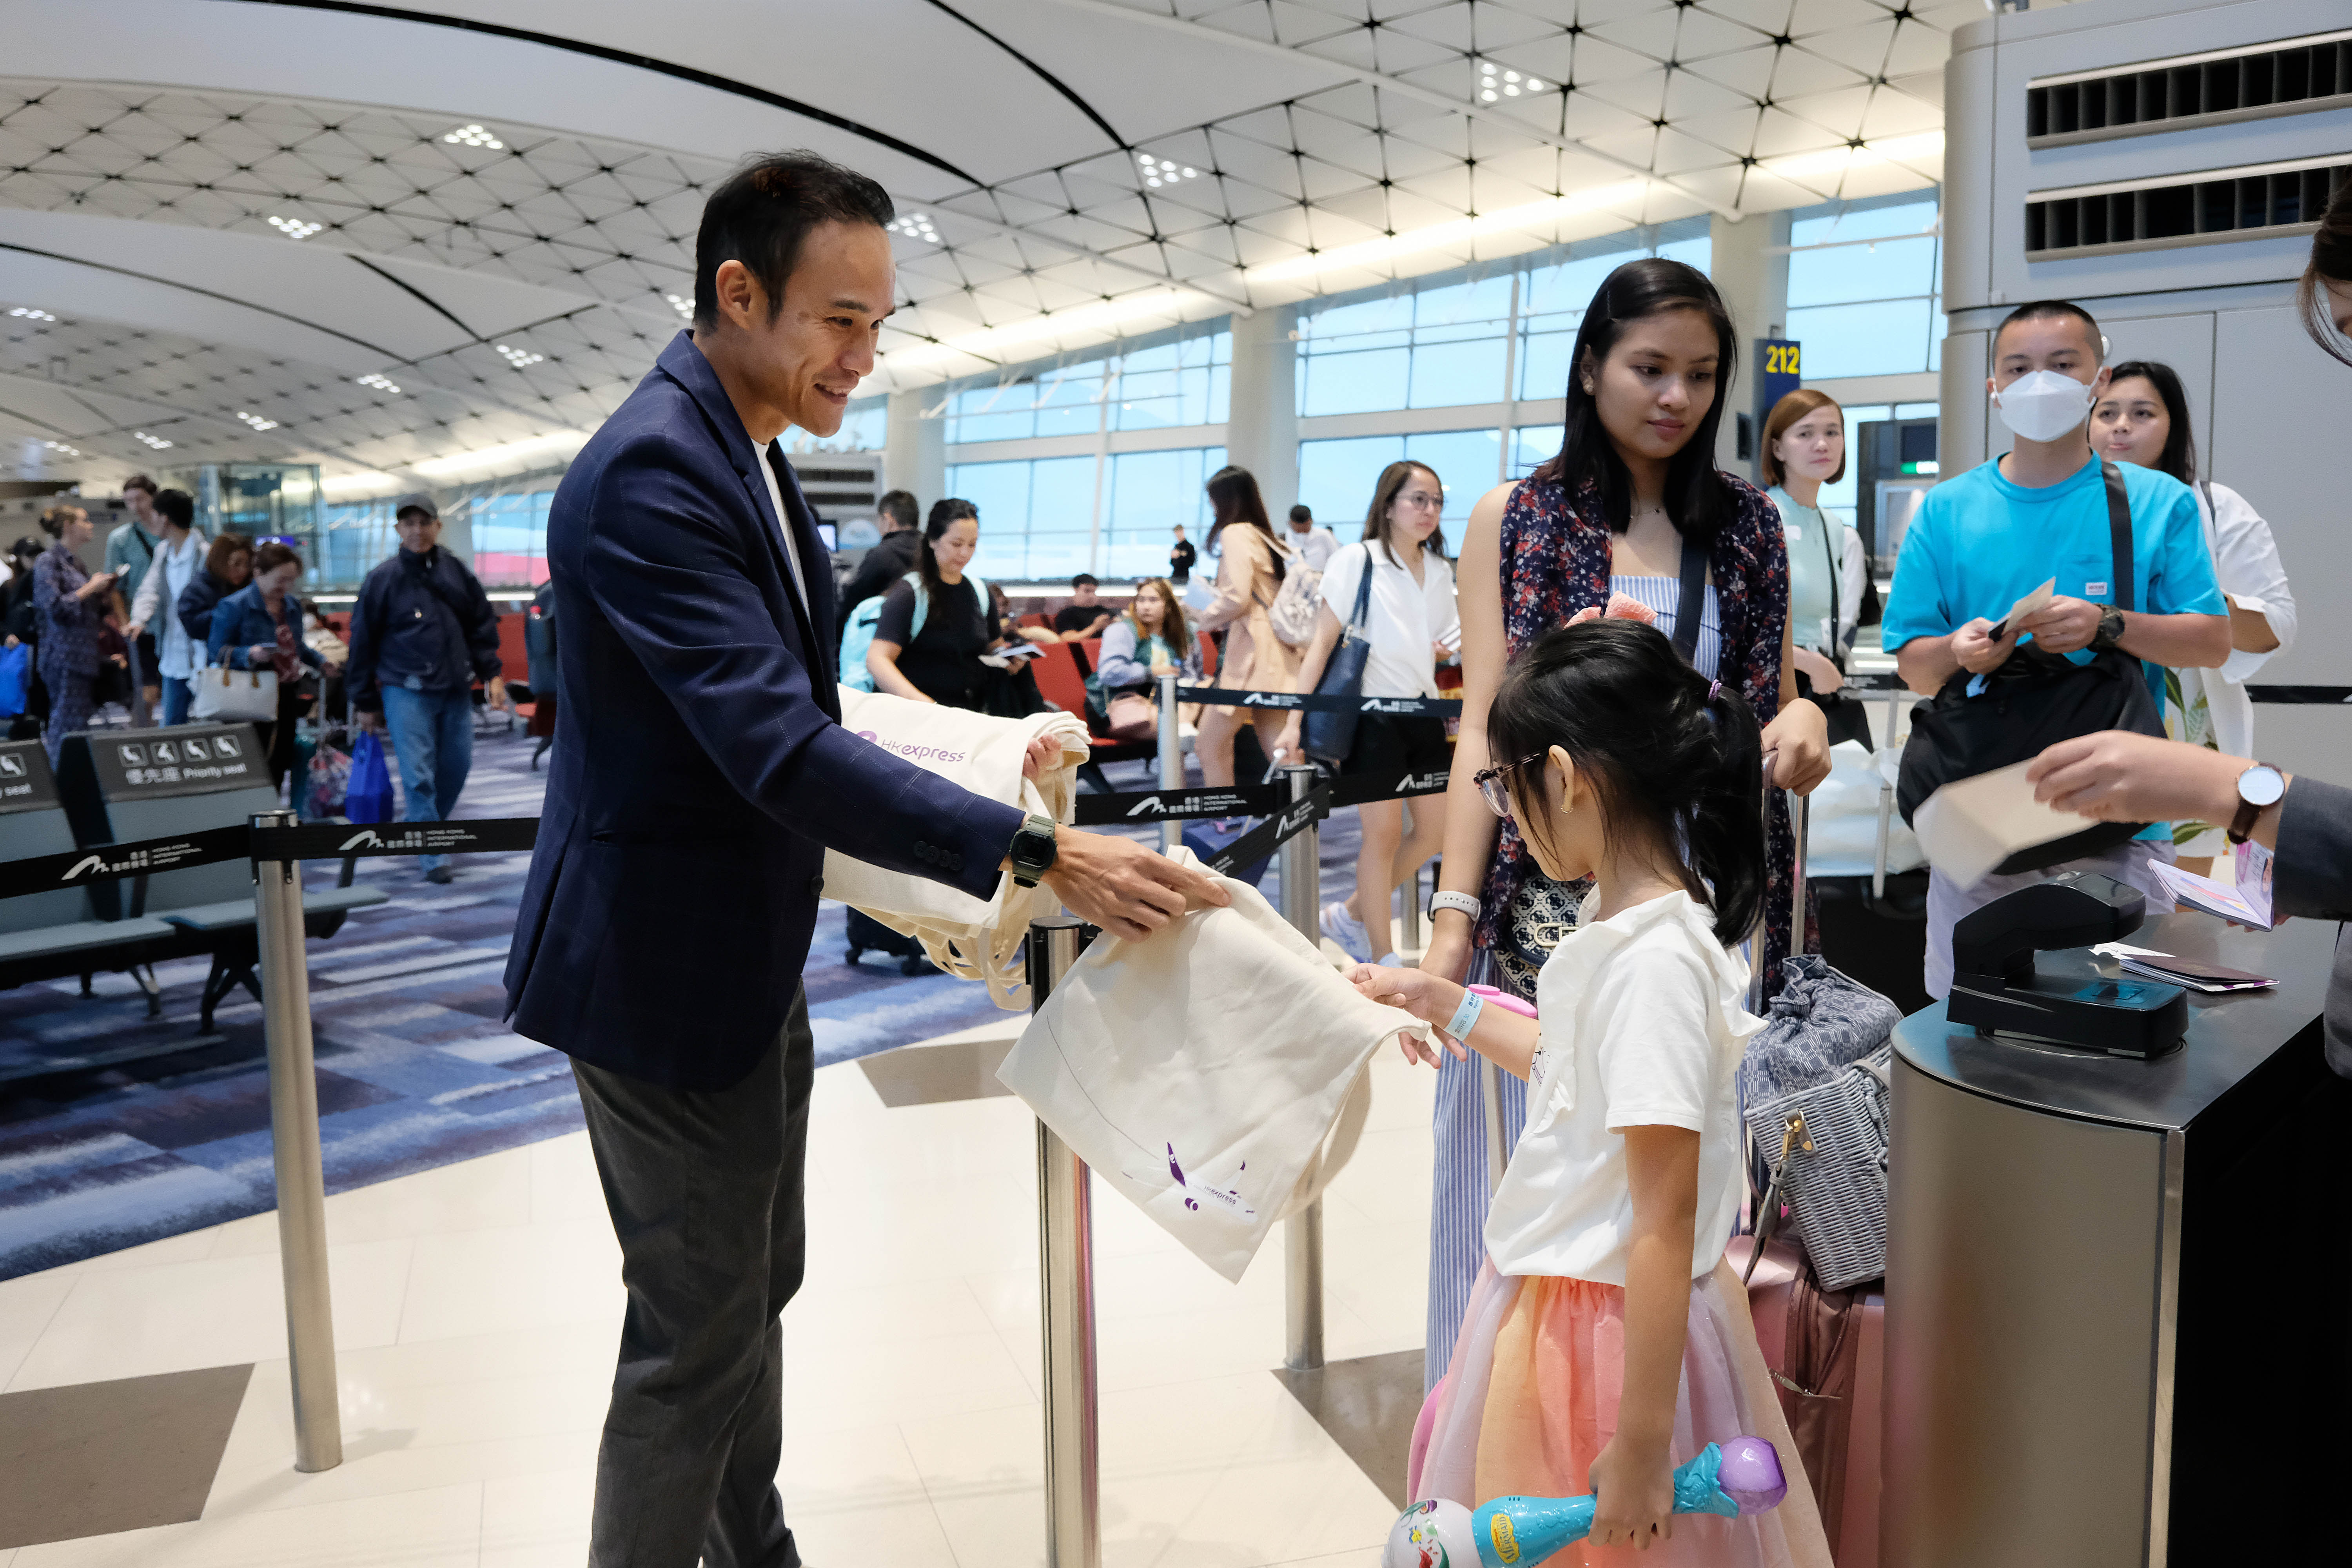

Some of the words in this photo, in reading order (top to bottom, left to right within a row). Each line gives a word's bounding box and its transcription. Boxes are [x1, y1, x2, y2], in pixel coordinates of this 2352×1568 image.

[1766, 345, 1799, 374] 212
[882, 739, 965, 762] HKexpress
[183, 766, 222, 779] Priority
[222, 763, 247, 775] seat
[4, 783, 32, 796] seat
[1499, 1517, 1515, 1559] MERMAID
